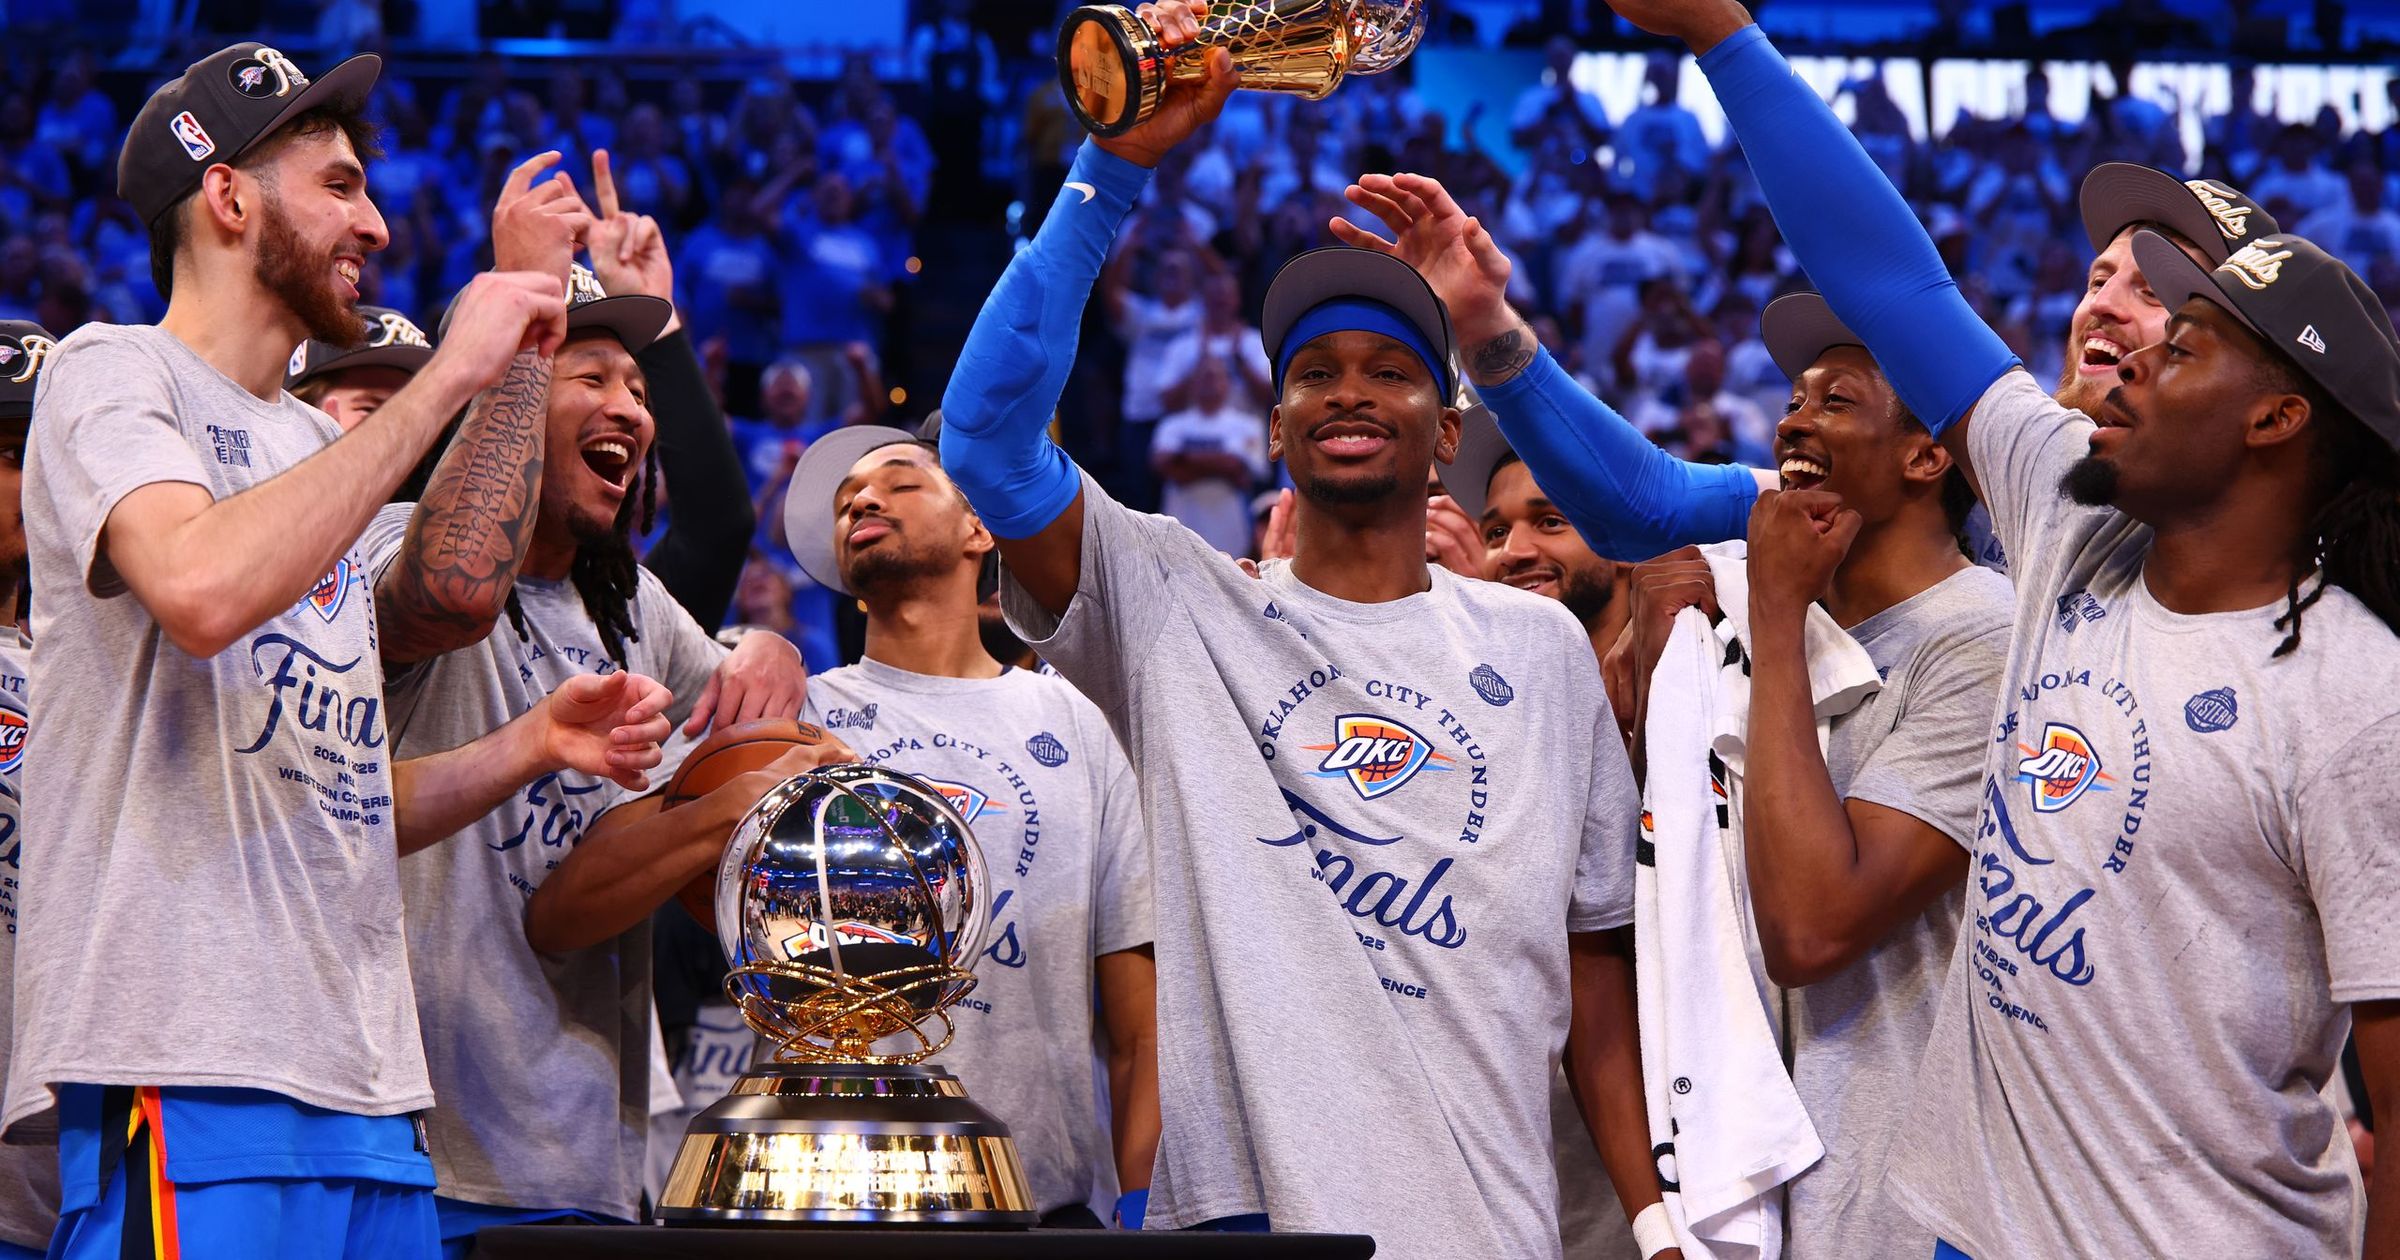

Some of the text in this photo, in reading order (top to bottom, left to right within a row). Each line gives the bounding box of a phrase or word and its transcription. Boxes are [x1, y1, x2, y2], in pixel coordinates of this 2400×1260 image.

[234, 633, 385, 754] Fina
[1471, 673, 1512, 698] WESTERN
[2101, 677, 2138, 718] CITY
[2188, 696, 2235, 727] WESTERN
[313, 745, 346, 766] 2024
[1323, 736, 1411, 770] OKC
[1365, 680, 1432, 711] CITY
[1437, 708, 1488, 845] THUNDER
[2019, 747, 2089, 779] OKC
[278, 767, 338, 802] WESTERN
[2101, 718, 2152, 875] THUNDER
[932, 733, 992, 761] CITY
[996, 762, 1041, 878] THUNDER
